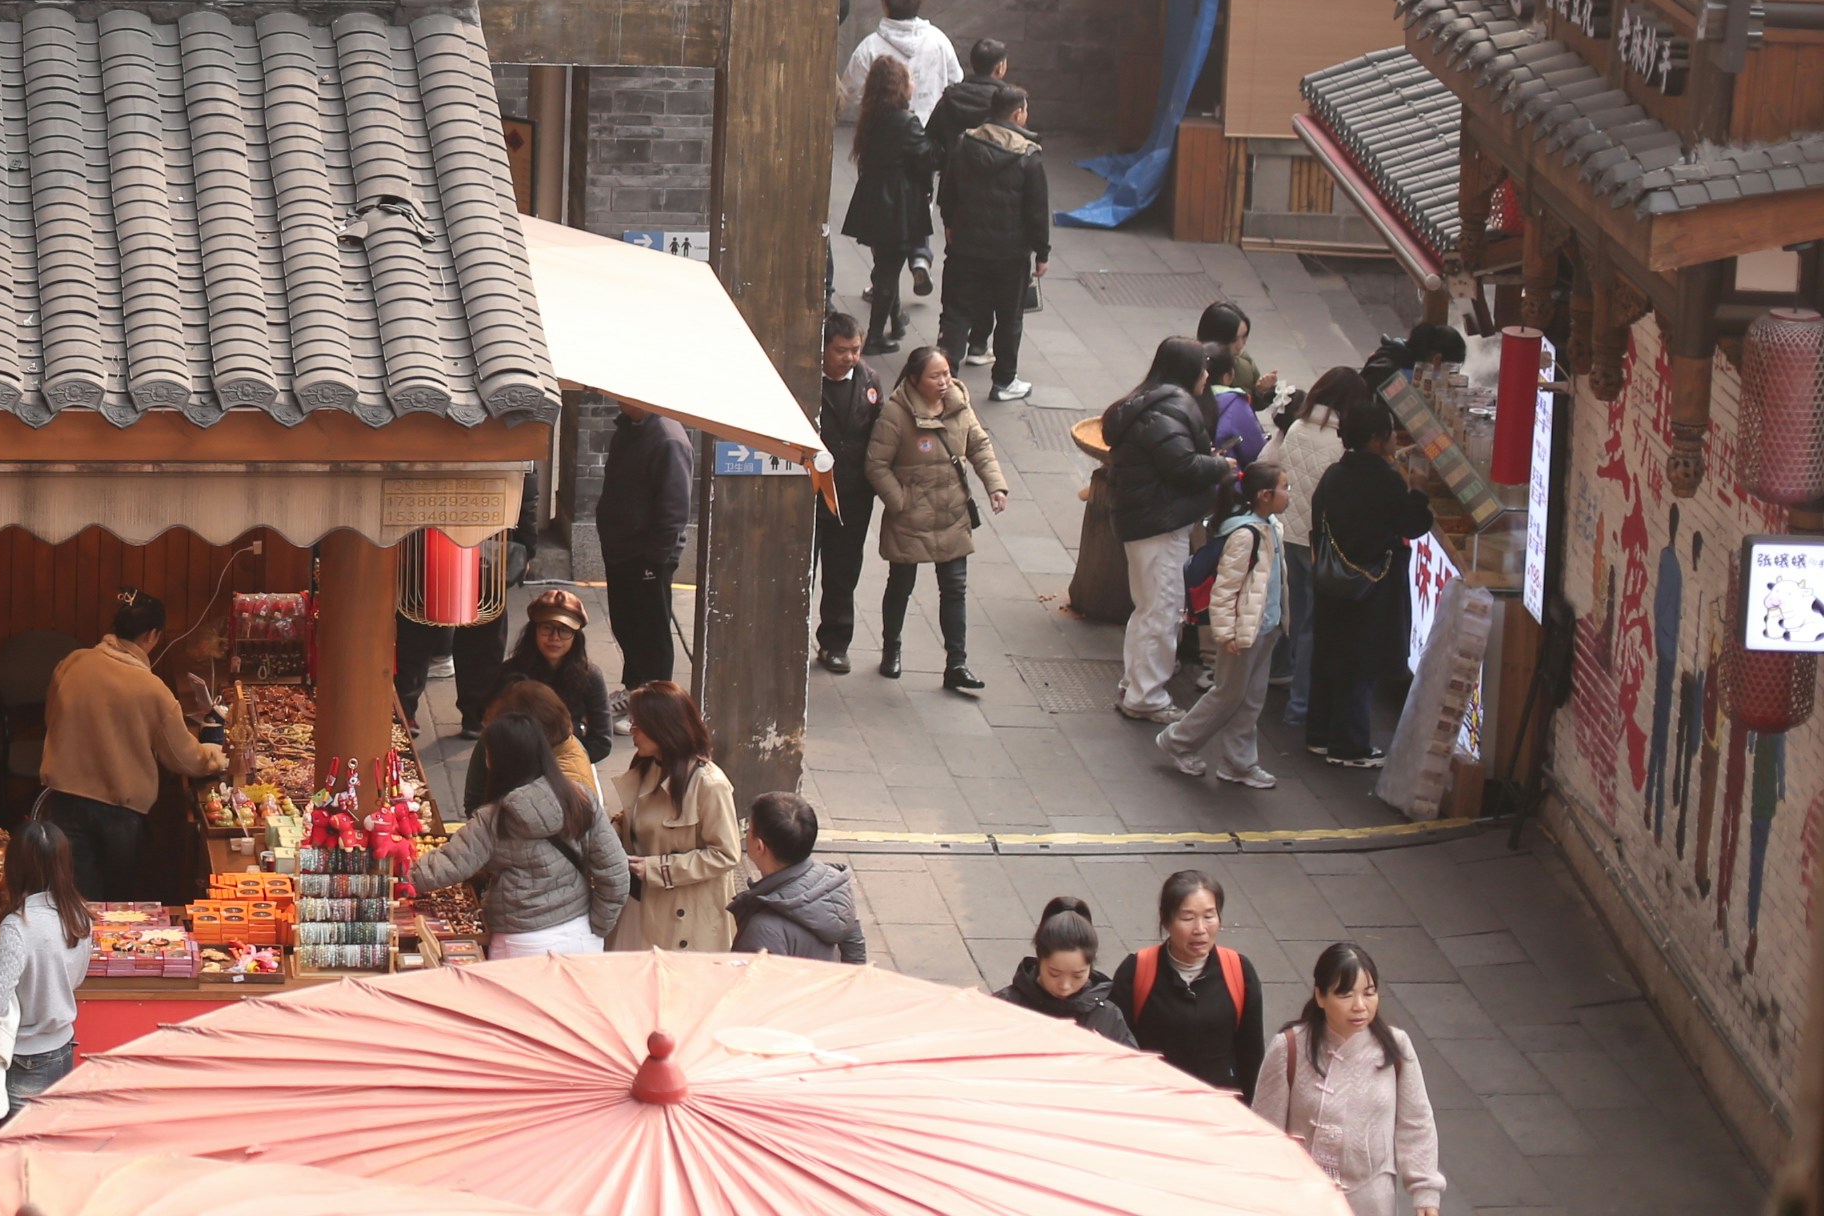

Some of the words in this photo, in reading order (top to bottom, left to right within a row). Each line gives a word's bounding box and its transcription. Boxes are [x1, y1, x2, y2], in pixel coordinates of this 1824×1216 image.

[1618, 8, 1673, 95] 老麻抄手
[724, 463, 753, 473] 卫生间
[387, 496, 500, 507] 17388292493
[387, 511, 500, 522] 15334602598
